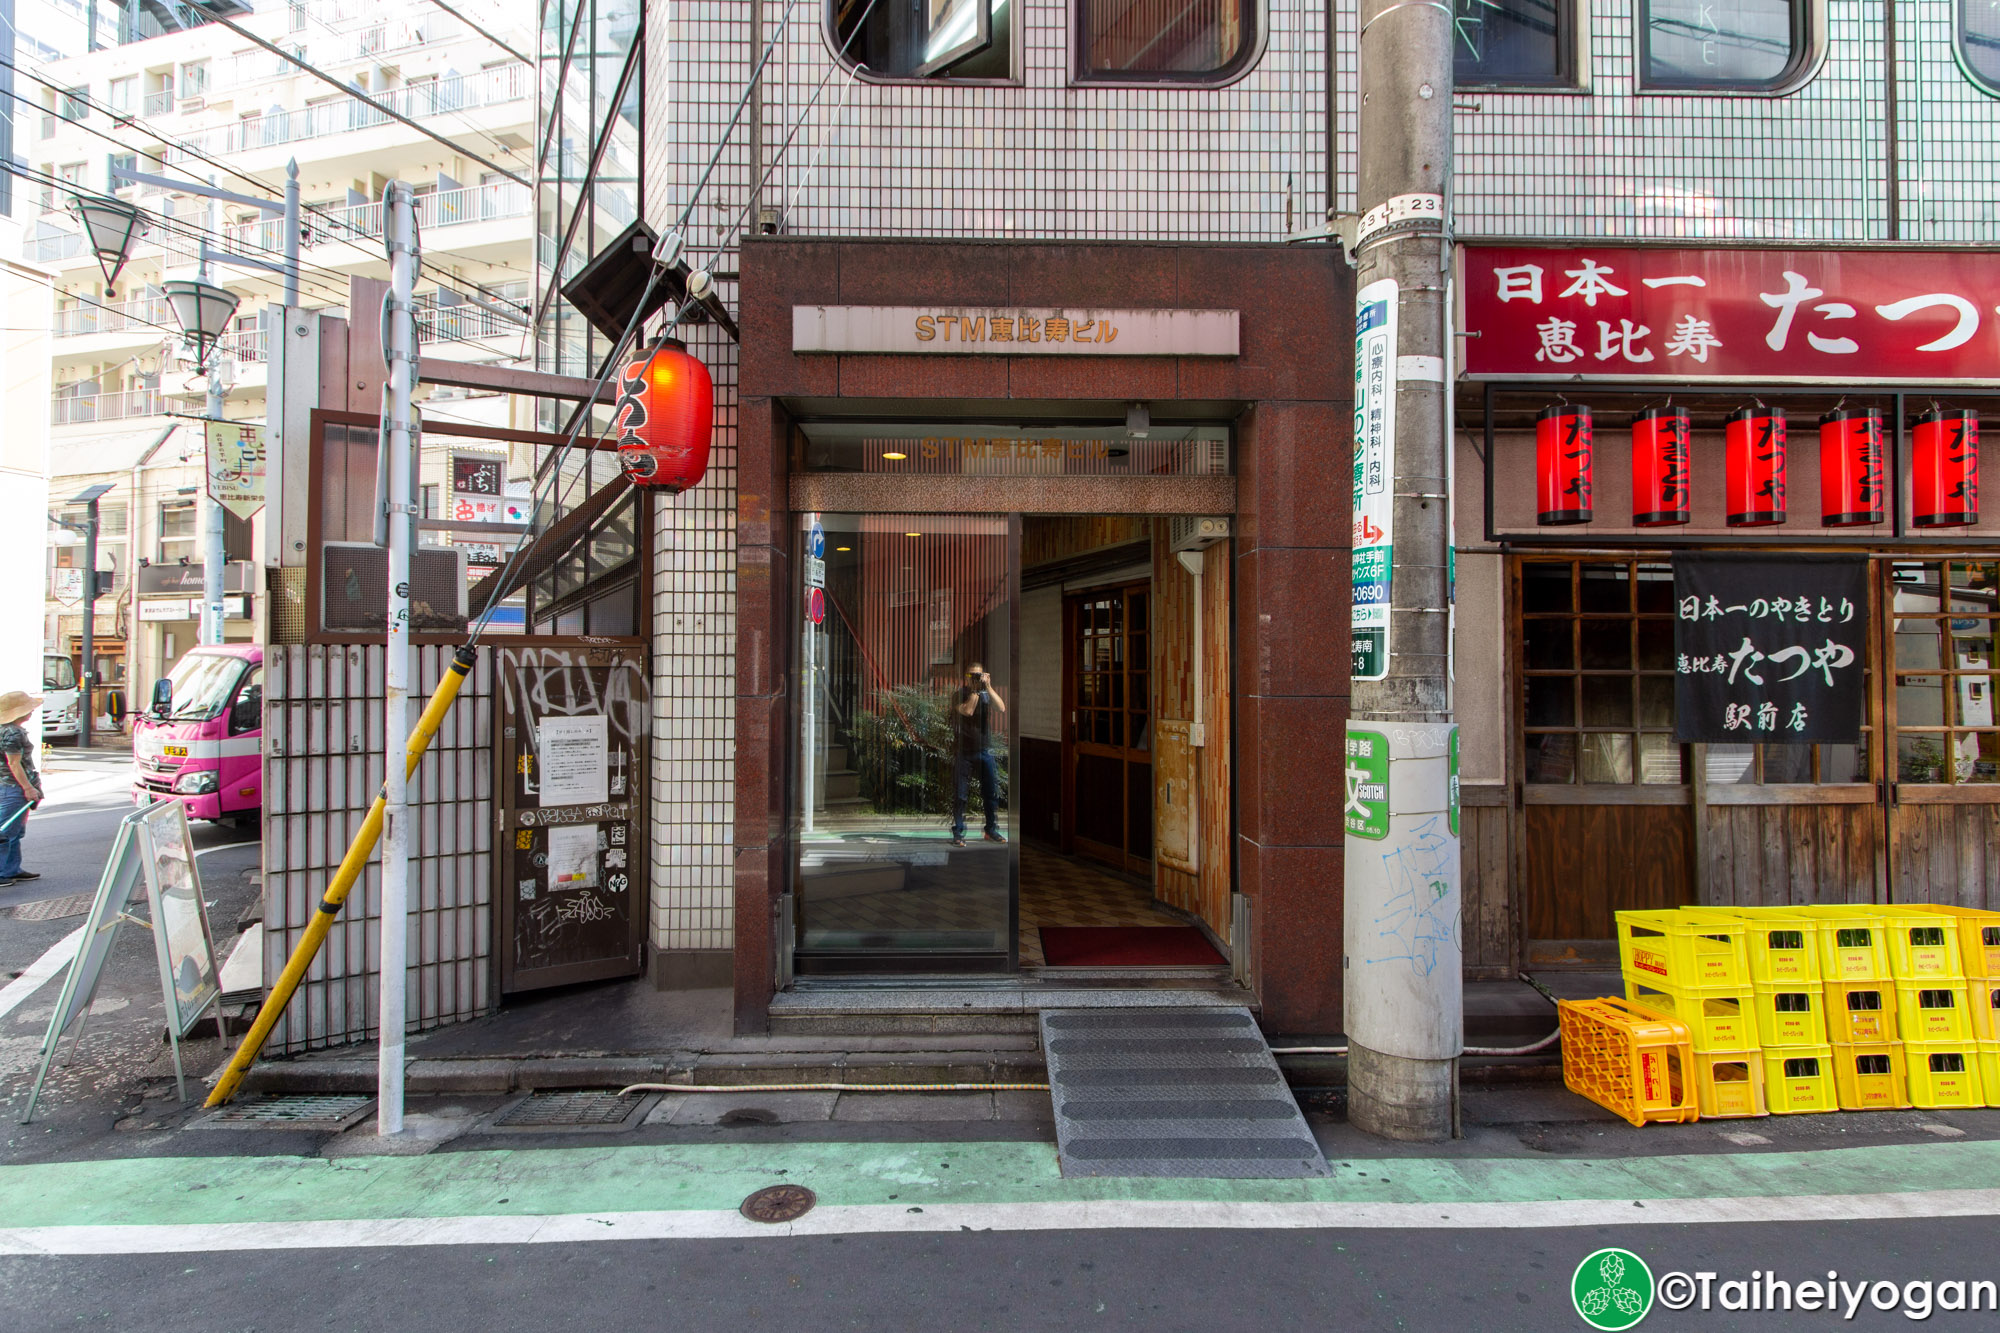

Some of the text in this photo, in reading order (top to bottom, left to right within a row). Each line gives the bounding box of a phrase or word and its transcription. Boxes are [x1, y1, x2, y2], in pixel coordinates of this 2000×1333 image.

[1494, 258, 1707, 307] 日本一
[914, 315, 1119, 344] STM恵比寿ビル
[1760, 270, 2000, 355] たつ
[1535, 314, 1723, 363] 恵比寿
[1369, 342, 1384, 487] 心療内科・精神科・内科
[1564, 416, 1592, 508] たつや
[1658, 418, 1690, 510] やきとり
[1755, 418, 1786, 510] たつや
[1854, 419, 1883, 510] やきとり
[1948, 420, 1979, 511] たつや
[1679, 594, 1855, 623] 日本一のやきとり
[1677, 637, 1855, 688] 恵比寿 たつや
[1723, 701, 1809, 733] 駅前店
[1346, 738, 1372, 757] 学路
[1359, 784, 1384, 800] SCOTCH
[1634, 948, 1654, 965] HOPPY
